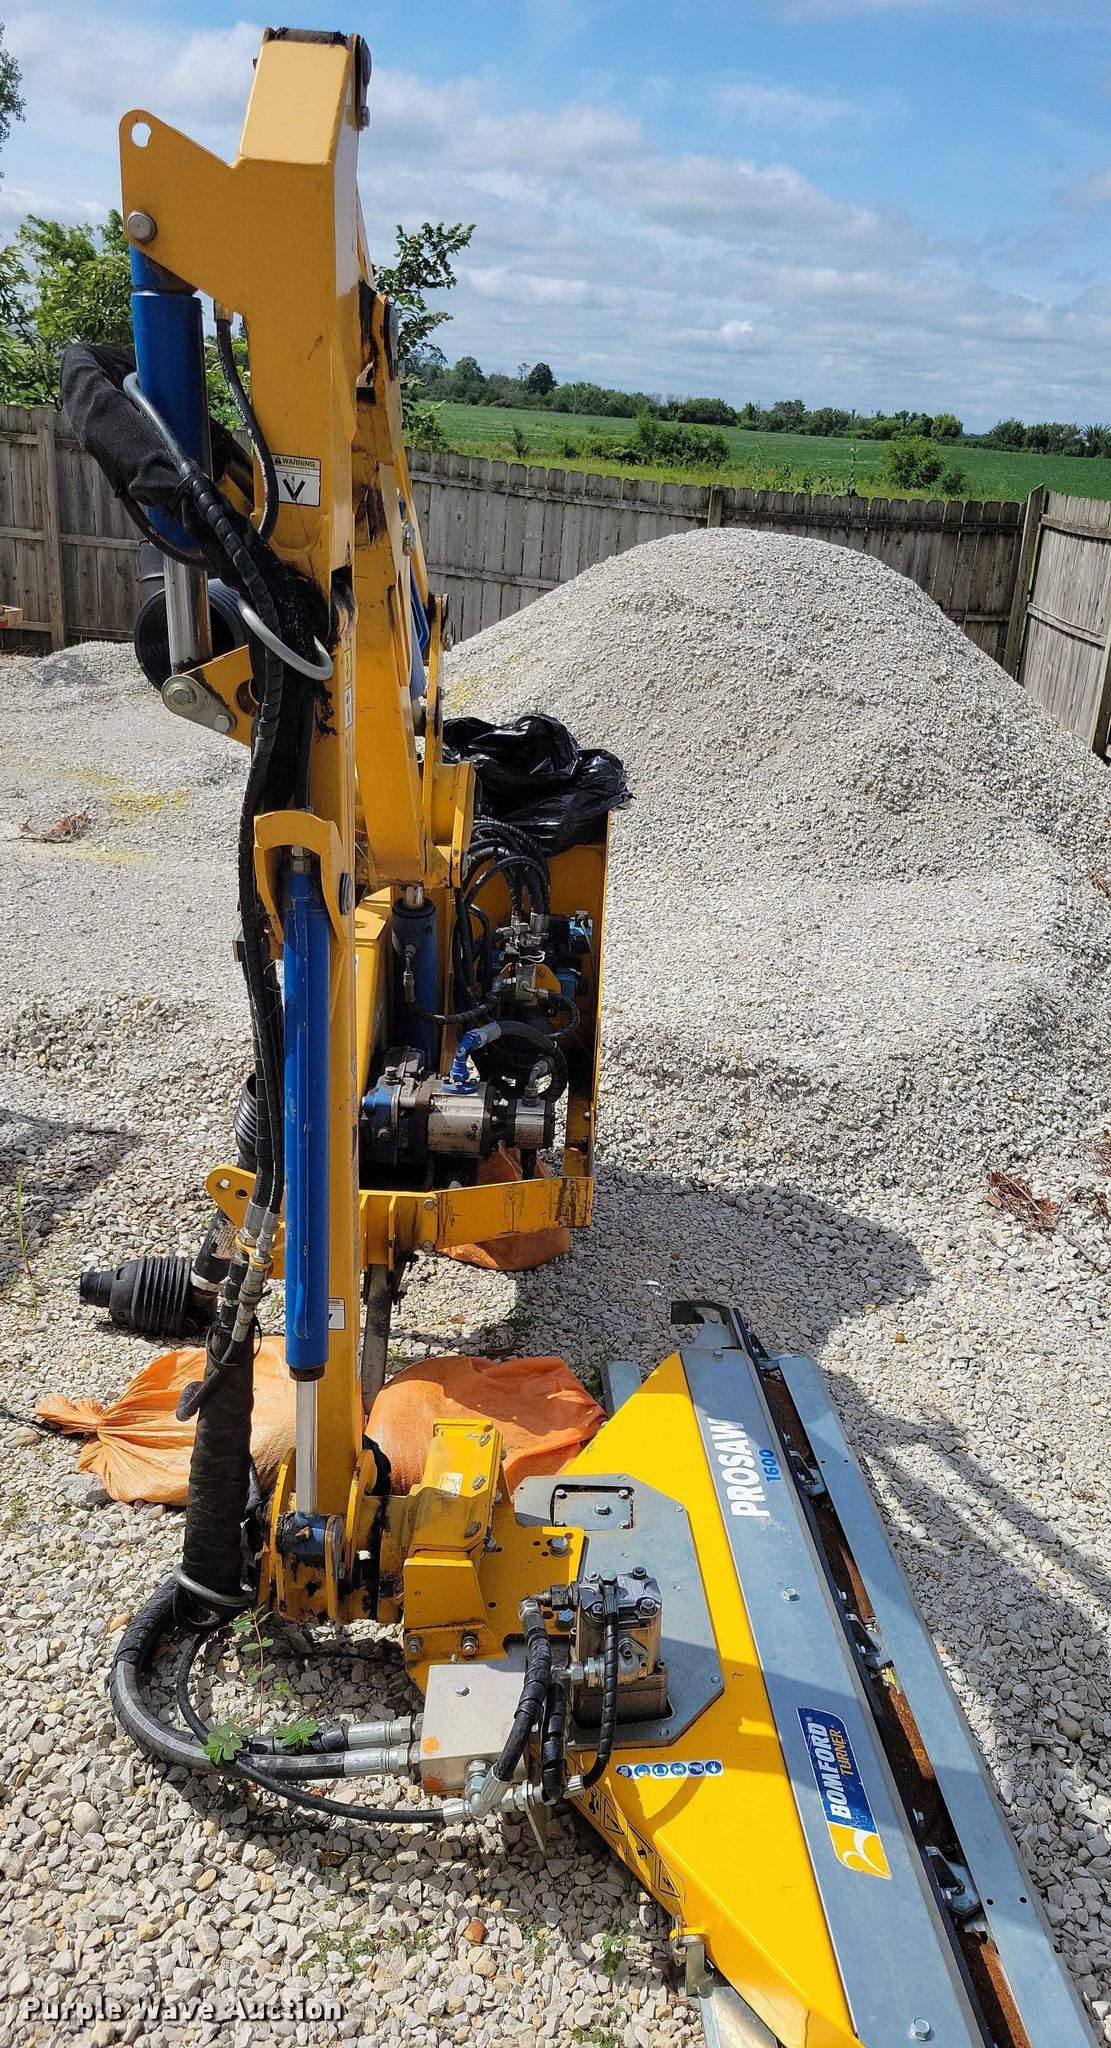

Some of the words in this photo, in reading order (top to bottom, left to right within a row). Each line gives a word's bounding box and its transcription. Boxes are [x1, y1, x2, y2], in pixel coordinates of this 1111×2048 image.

[282, 457, 316, 468] WARNING
[706, 1417, 771, 1517] PROSAW
[758, 1448, 782, 1482] 1600
[807, 1721, 852, 1820] BOMFORD
[829, 1728, 854, 1776] TURNER
